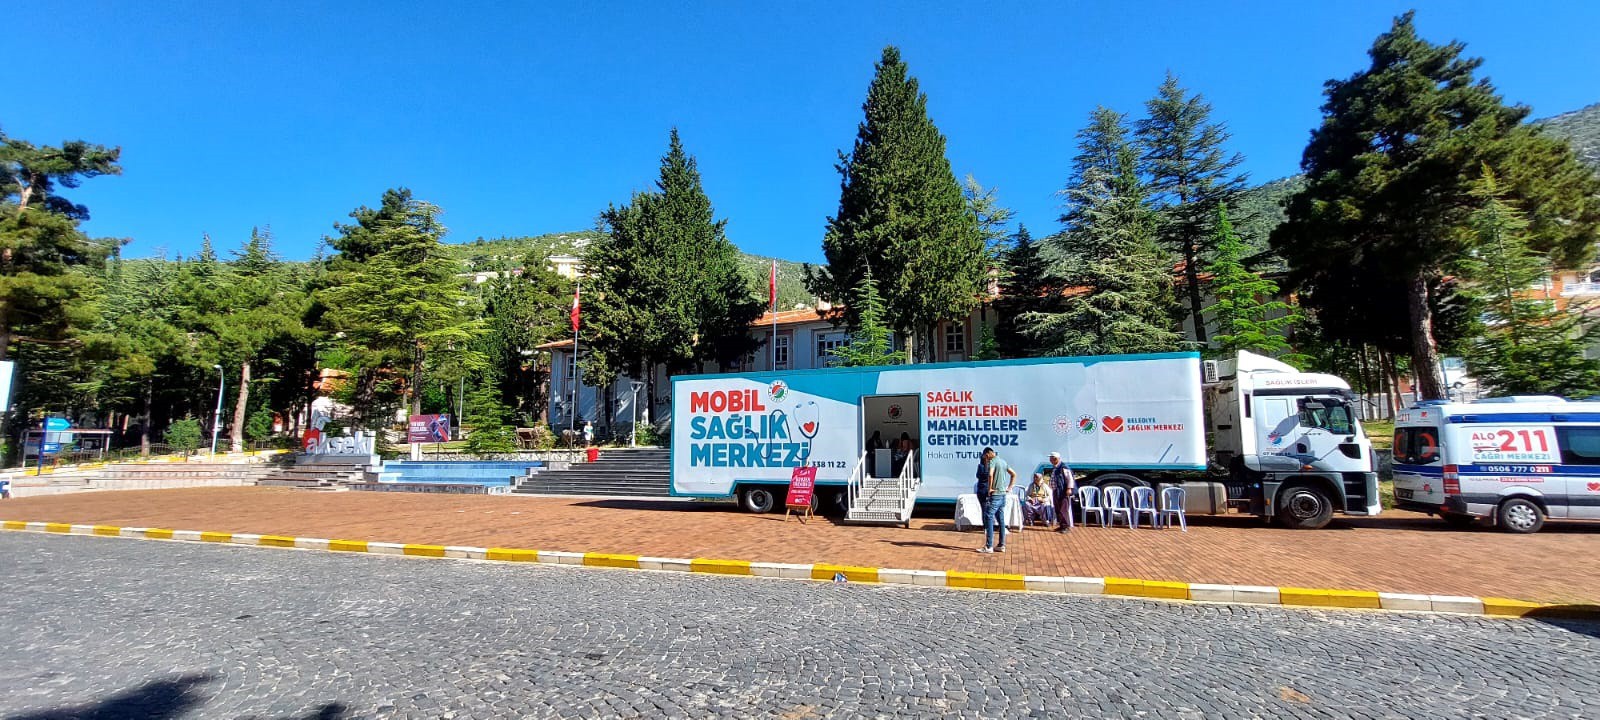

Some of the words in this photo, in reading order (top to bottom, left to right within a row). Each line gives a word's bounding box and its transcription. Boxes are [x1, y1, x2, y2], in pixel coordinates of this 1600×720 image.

[926, 389, 973, 402] SAĞLIK
[927, 405, 1018, 417] HİZMETLERİNİ
[690, 414, 788, 440] SAĞLIK
[927, 420, 1027, 431] MAHALLELERE
[927, 433, 1019, 446] GETİRİYORUZ
[1472, 432, 1495, 440] ALO
[1496, 430, 1548, 451] 211
[927, 451, 953, 459] Hakan
